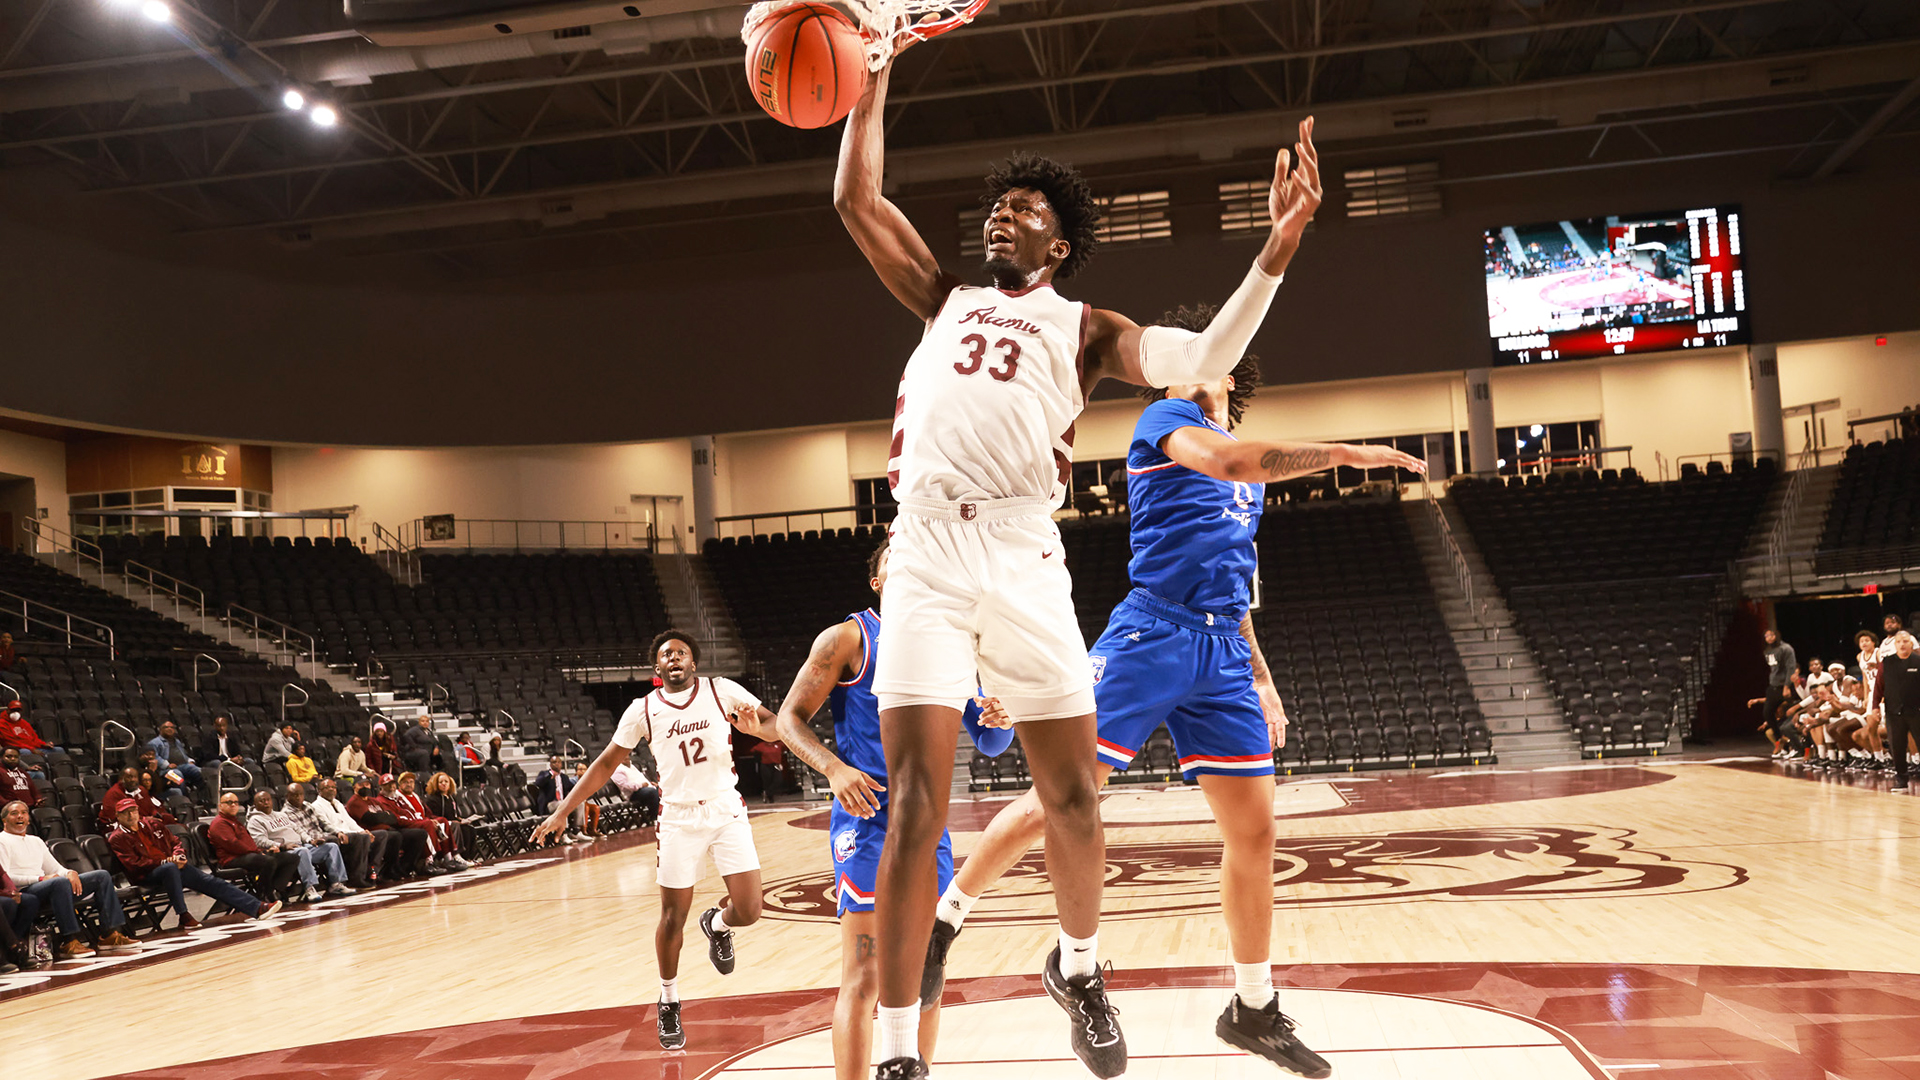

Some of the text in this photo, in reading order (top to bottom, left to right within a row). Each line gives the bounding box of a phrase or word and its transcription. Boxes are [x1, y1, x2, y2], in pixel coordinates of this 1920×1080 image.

[760, 48, 777, 112] ELITE
[1714, 333, 1727, 346] 11
[953, 333, 1021, 382] 33
[1517, 350, 1530, 363] 11
[666, 719, 710, 738] Aamu
[678, 737, 707, 767] 12
